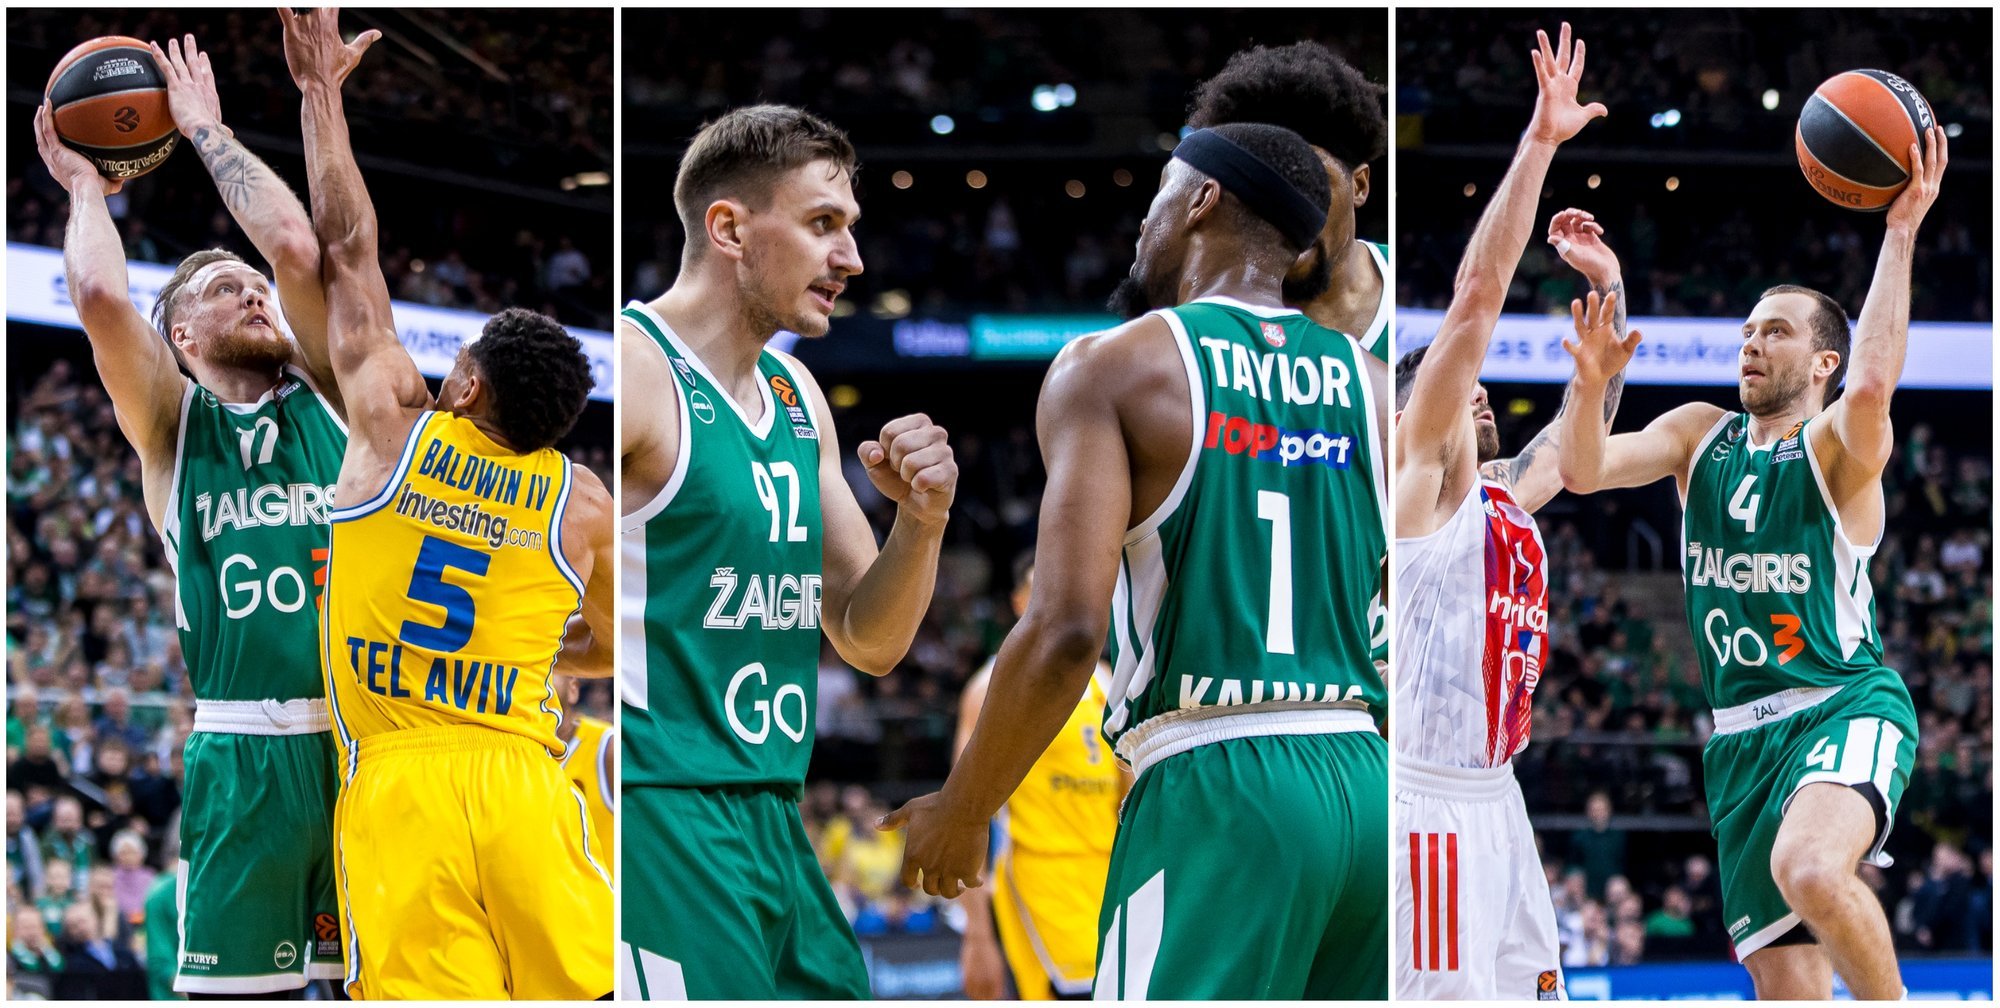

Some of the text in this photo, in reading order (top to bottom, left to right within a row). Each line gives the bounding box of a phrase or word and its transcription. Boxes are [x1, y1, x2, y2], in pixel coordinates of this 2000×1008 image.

[94, 137, 174, 172] SPALDIN
[1199, 336, 1352, 409] TAYLOR
[236, 416, 279, 471] 17
[418, 438, 551, 512] BALDWIN IV
[751, 461, 808, 542] 92
[1728, 473, 1761, 533] 4
[195, 483, 337, 542] ŽALGIR
[399, 535, 492, 653] 5
[1257, 489, 1295, 655] 1
[1688, 542, 1811, 594] ŽALGIRIS
[703, 567, 822, 631] ŽALGIR
[1704, 608, 1805, 667] Go3
[347, 636, 519, 716] TEL AVIV
[724, 662, 807, 744] Go
[1179, 674, 1363, 709] KAUNA
[1753, 703, 1779, 721] ŽAL
[1806, 736, 1839, 770] 4
[184, 951, 218, 965] TURYS
